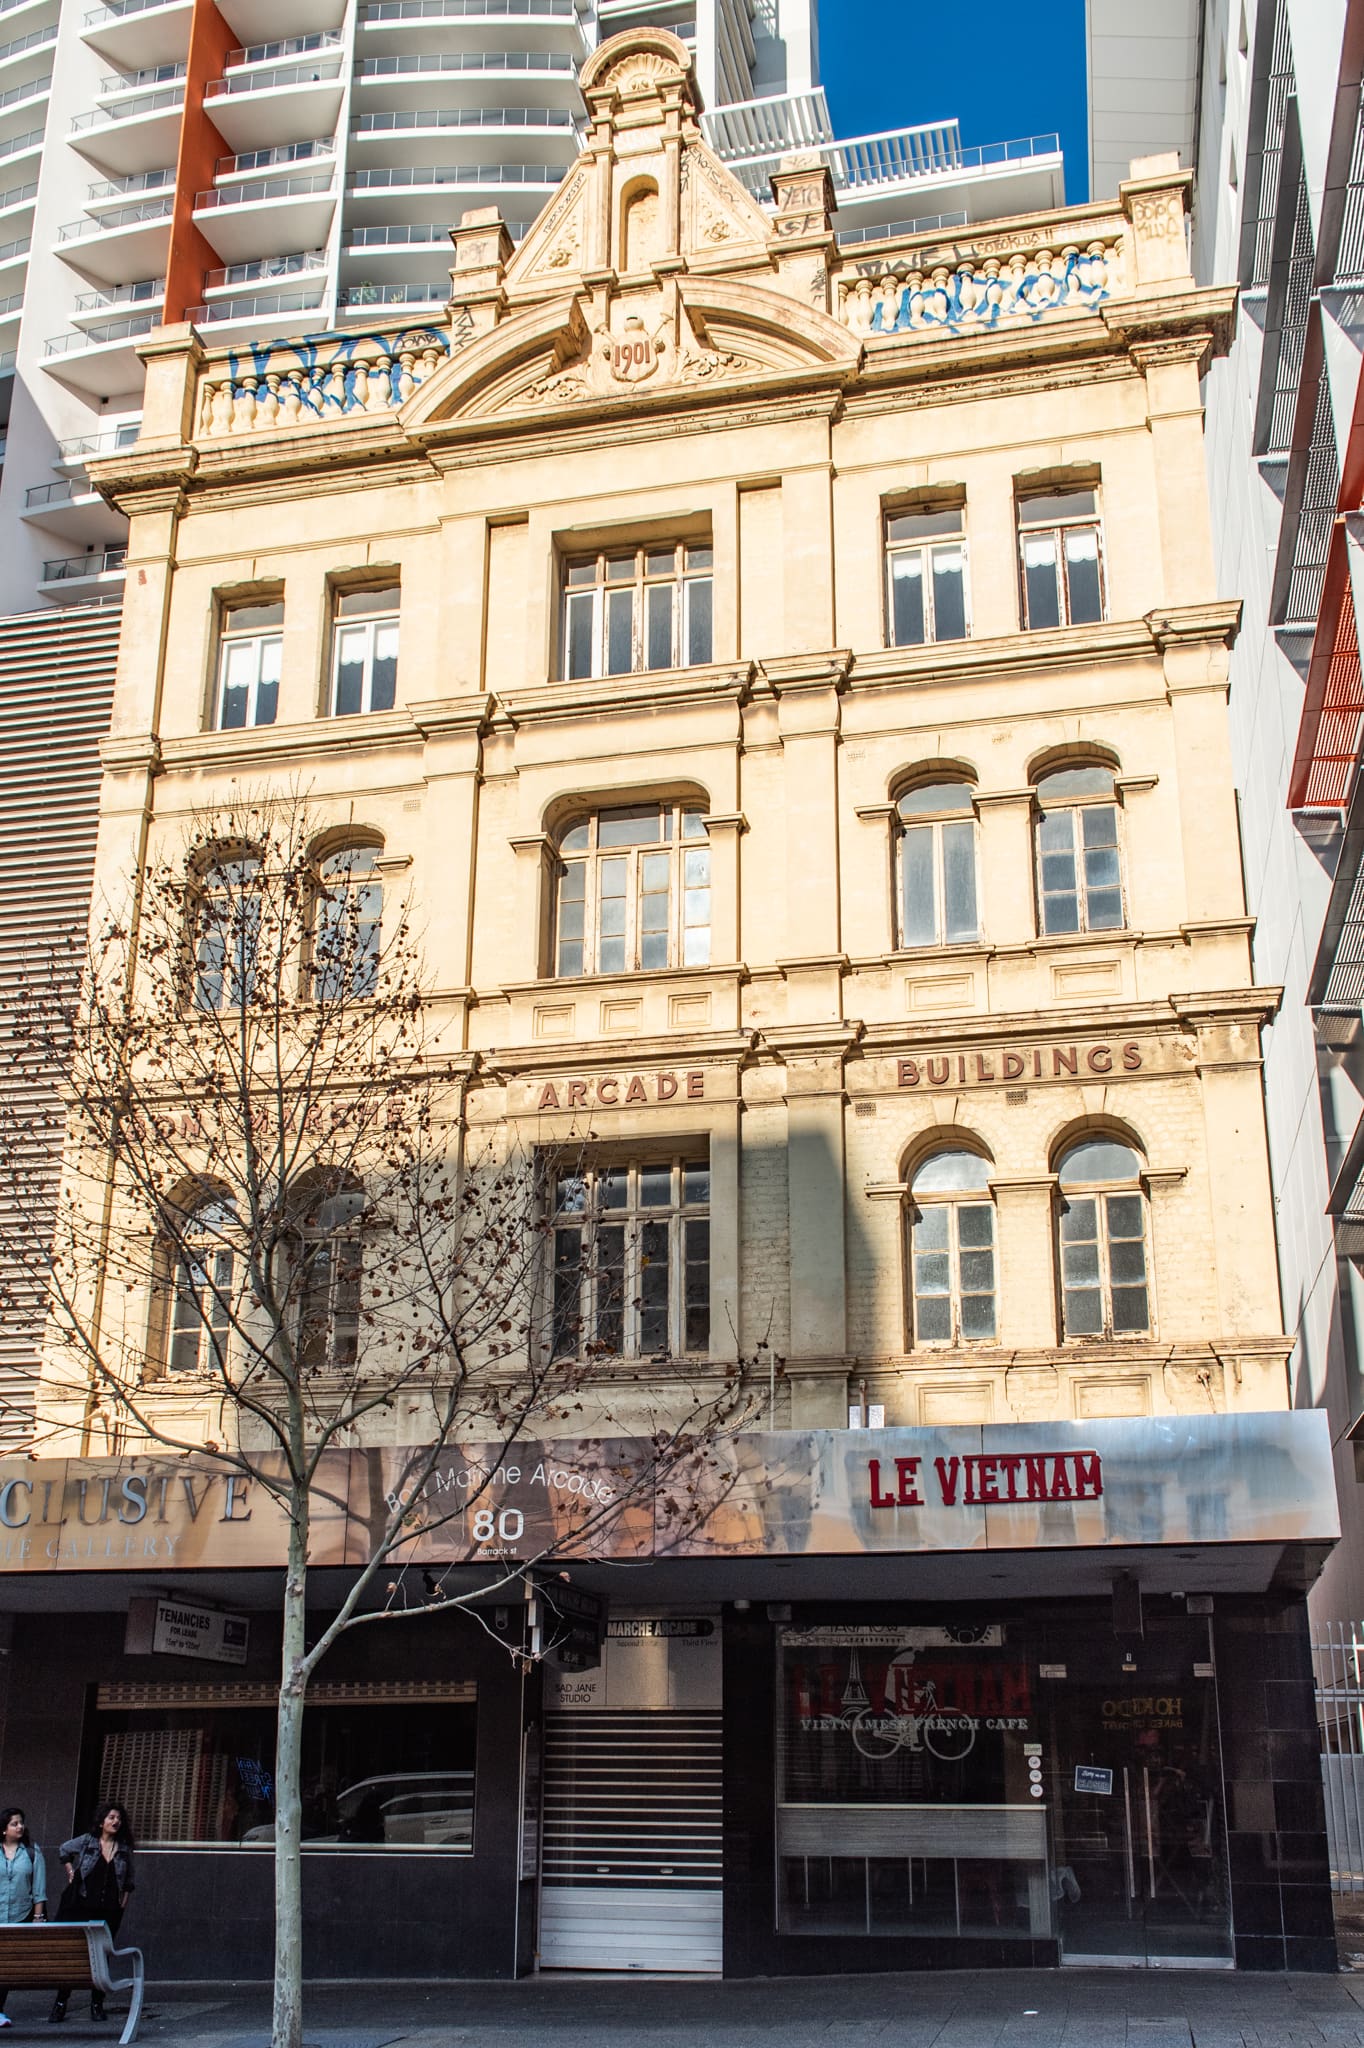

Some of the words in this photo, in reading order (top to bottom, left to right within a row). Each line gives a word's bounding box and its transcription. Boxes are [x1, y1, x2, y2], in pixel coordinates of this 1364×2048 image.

[614, 341, 651, 374] 1901
[897, 1042, 1142, 1087] BUILDINGS
[538, 1071, 704, 1110] ARCADE
[530, 1463, 616, 1504] Arcade
[868, 1457, 925, 1508] LE
[934, 1451, 1103, 1505] VIETNAM
[472, 1508, 524, 1542] 80
[45, 1536, 182, 1560] GALLERY
[477, 1547, 509, 1556] Barrack
[159, 1607, 211, 1630] TENANCIES
[607, 1622, 652, 1637] MARCHE
[654, 1620, 697, 1636] ARCADE
[170, 1626, 181, 1636] FOR
[182, 1629, 198, 1639] LEASE
[555, 1684, 573, 1693] SAD
[575, 1683, 598, 1692] JANE
[560, 1694, 591, 1703] STUDIO
[800, 1718, 908, 1731] VIETNAMESE
[914, 1717, 979, 1731] FRENCH
[985, 1717, 1029, 1731] CAFE
